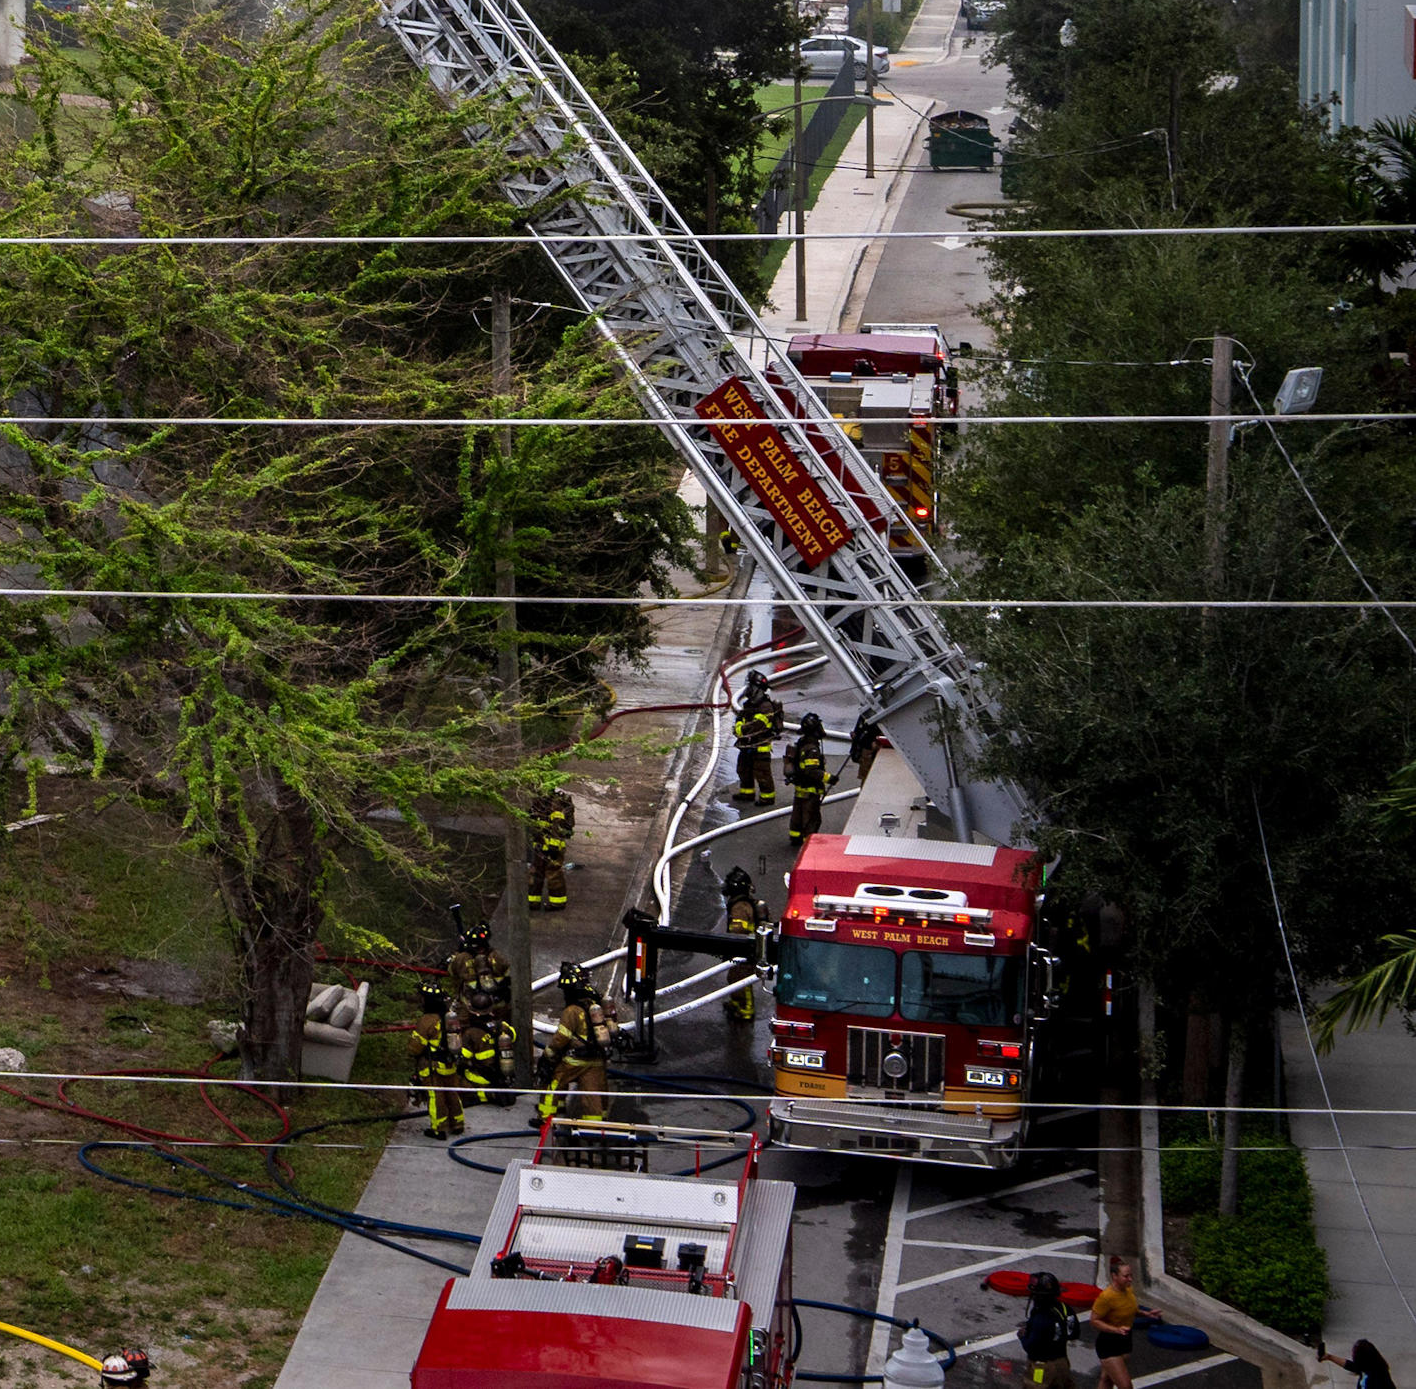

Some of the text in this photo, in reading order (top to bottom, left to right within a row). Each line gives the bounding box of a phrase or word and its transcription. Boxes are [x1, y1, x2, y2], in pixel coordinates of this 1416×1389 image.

[722, 386, 844, 545] WEST PALM BEACH
[889, 456, 899, 471] 5
[736, 445, 822, 555] DEPARTMENT
[852, 929, 949, 946] WEST PALM BEACH
